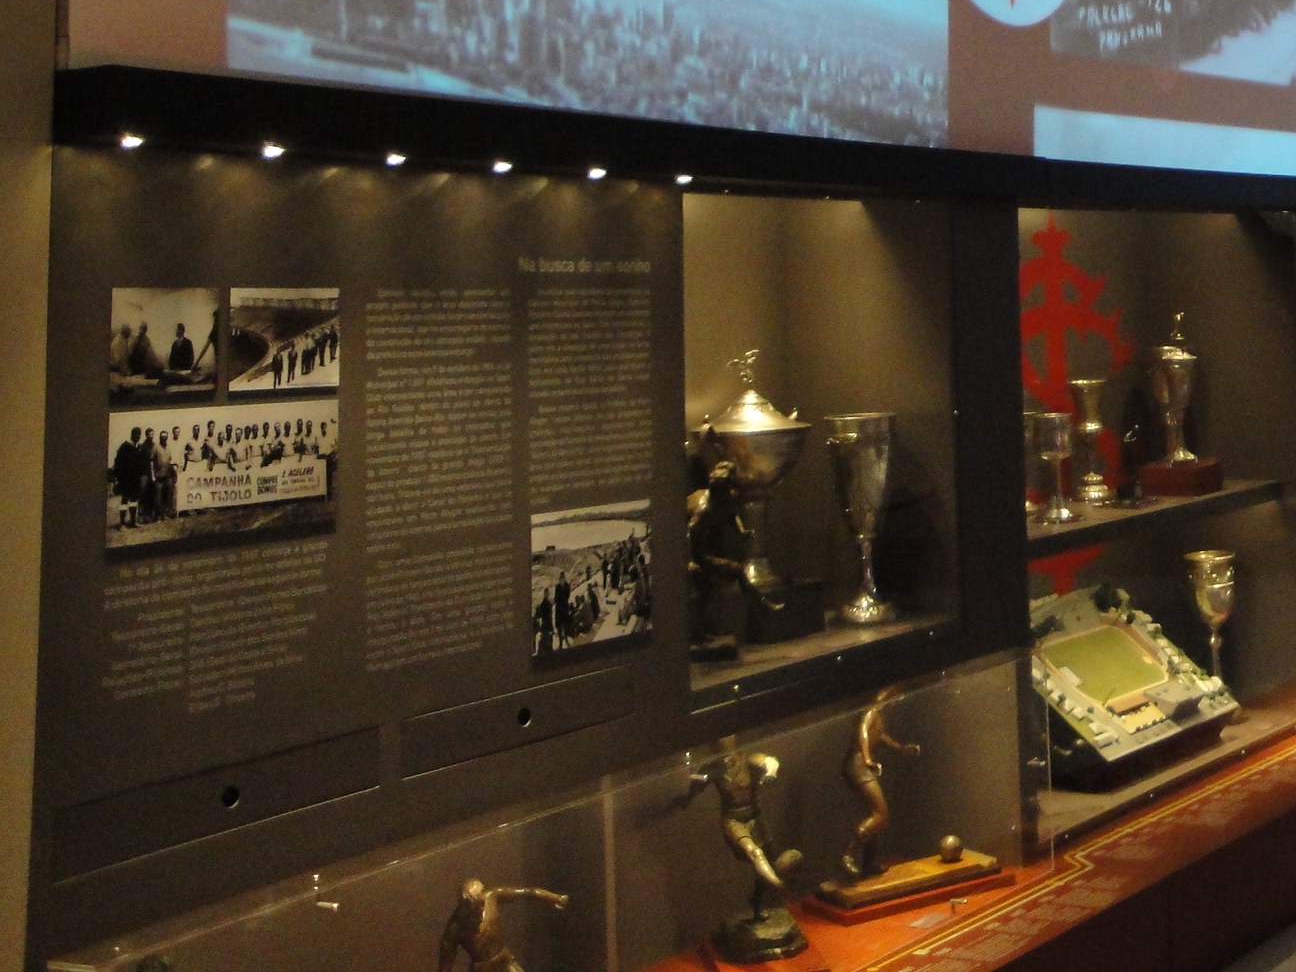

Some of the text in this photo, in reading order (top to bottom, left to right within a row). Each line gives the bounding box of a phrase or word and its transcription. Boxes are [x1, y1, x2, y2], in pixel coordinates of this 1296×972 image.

[578, 256, 592, 273] de
[187, 474, 251, 490] CAMPANHA
[187, 489, 251, 504] DO TIJOLO
